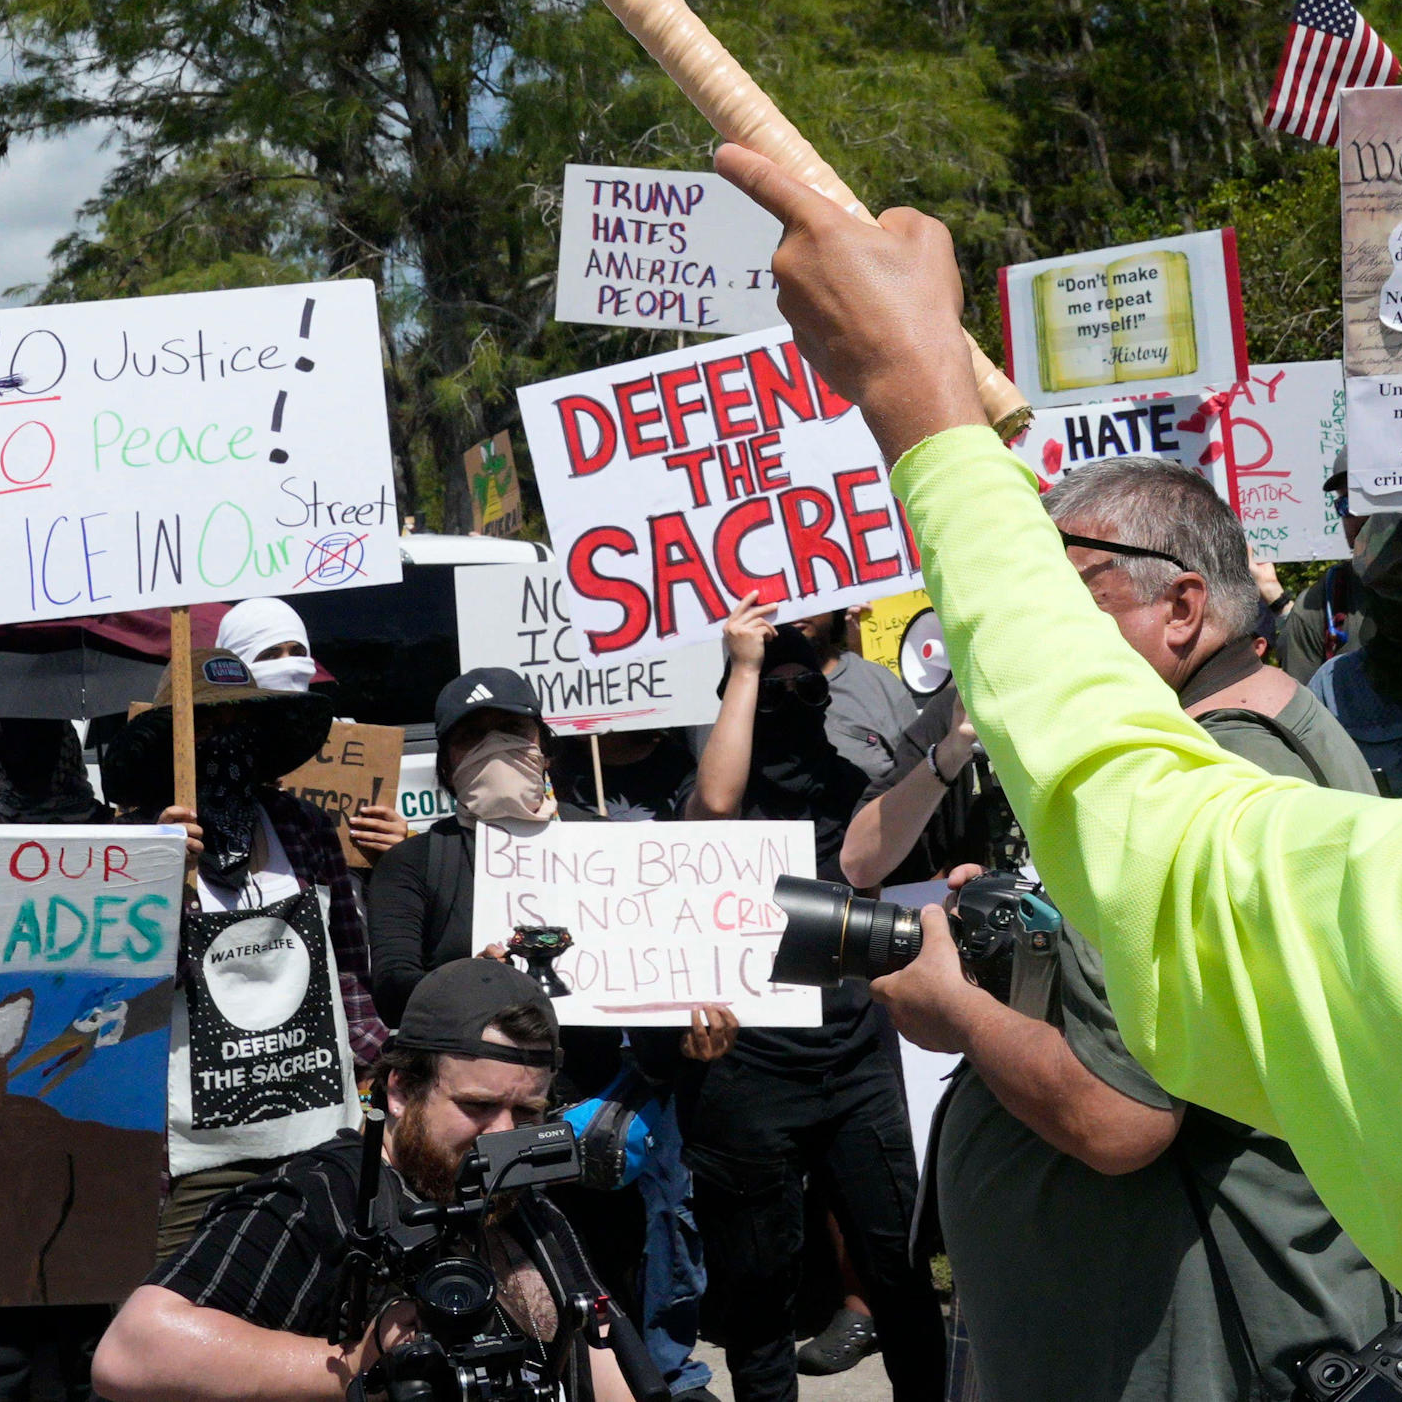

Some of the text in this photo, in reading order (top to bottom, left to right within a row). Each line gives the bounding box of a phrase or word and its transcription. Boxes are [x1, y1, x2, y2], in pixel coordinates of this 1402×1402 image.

[586, 179, 704, 217] TRUMP
[592, 213, 688, 255] HATES
[584, 248, 717, 289] AMERICA
[1112, 267, 1159, 286] make
[597, 285, 719, 327] PEOPLE
[1067, 290, 1152, 316] me repeat
[1064, 404, 1180, 462] HATE
[662, 431, 792, 510] THE
[276, 476, 396, 528] Street
[26, 511, 112, 611] ICE
[135, 511, 183, 595] IN
[198, 501, 295, 589] Our
[524, 660, 673, 713] NYWHERE
[9, 839, 139, 883] OUR
[485, 823, 792, 888] BEING BROWN
[505, 891, 547, 928] IS
[578, 887, 659, 932] NOT
[673, 898, 702, 935] A
[210, 937, 296, 965] WATER=LIFE
[221, 1027, 307, 1062] DEFEND
[198, 1048, 333, 1091] THE SACRED
[538, 1128, 566, 1140] SONY
